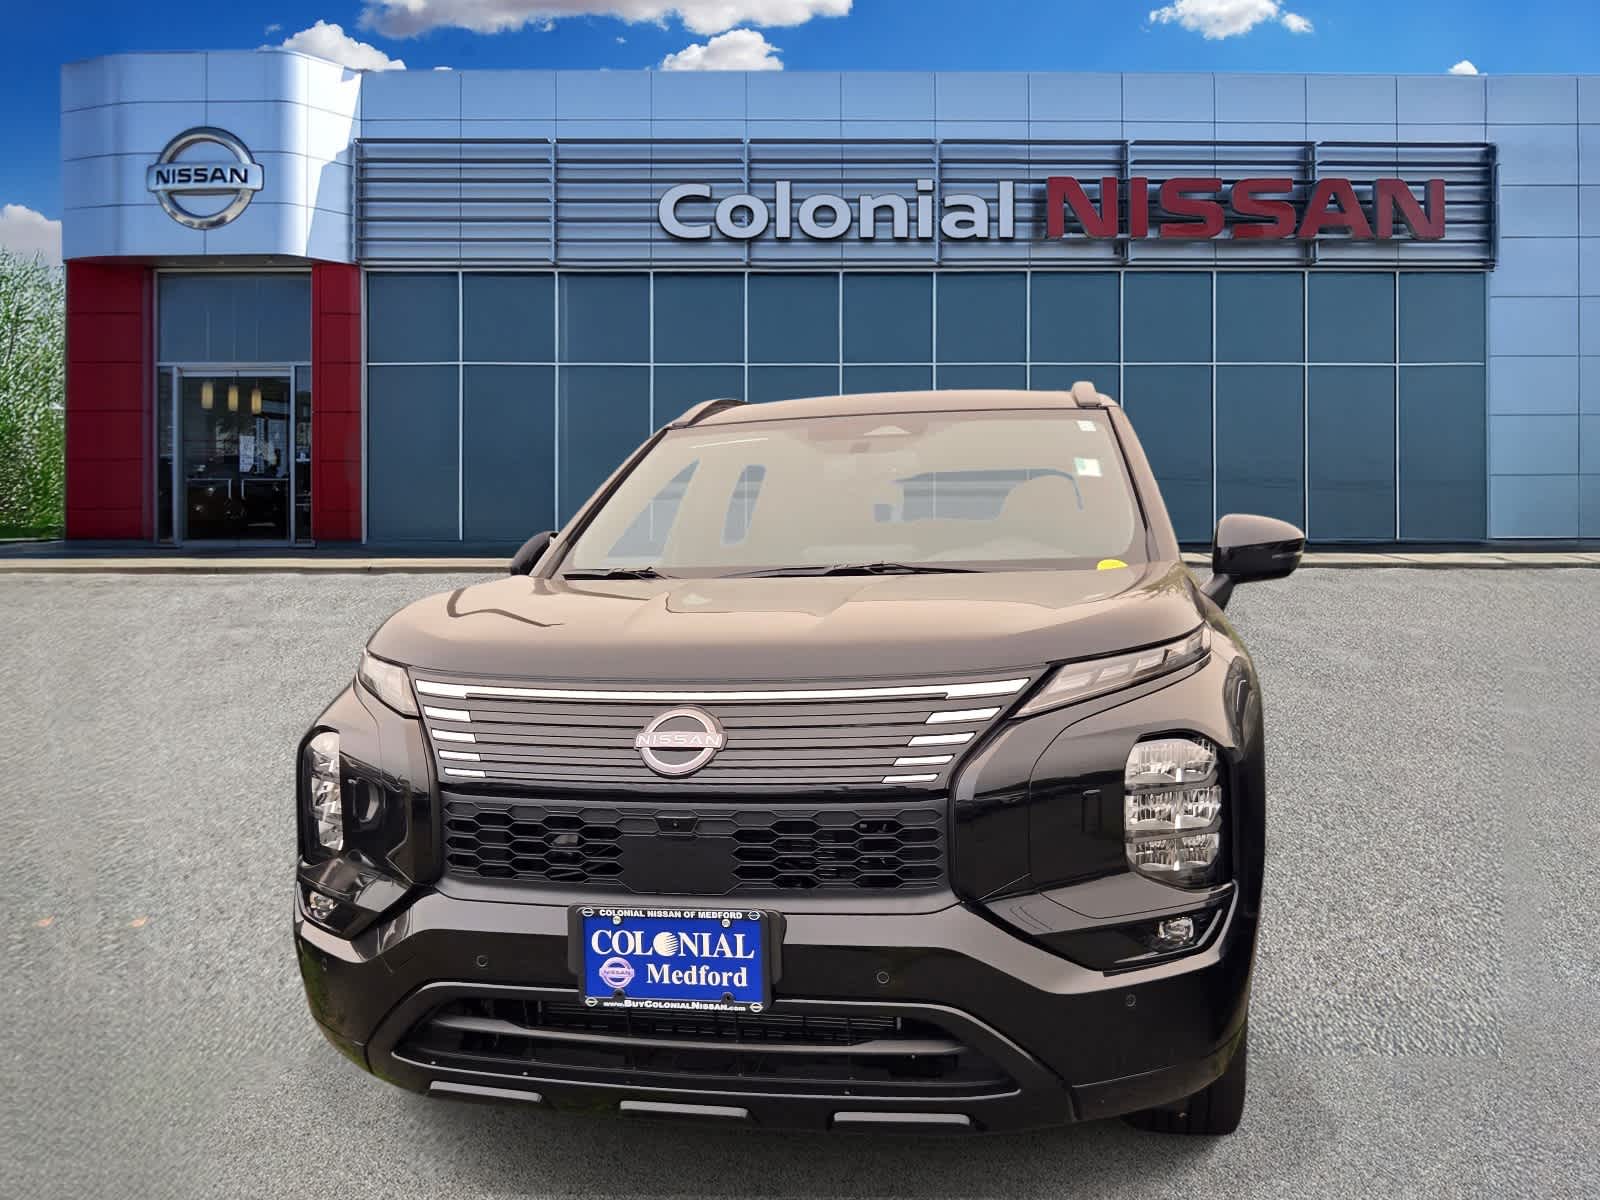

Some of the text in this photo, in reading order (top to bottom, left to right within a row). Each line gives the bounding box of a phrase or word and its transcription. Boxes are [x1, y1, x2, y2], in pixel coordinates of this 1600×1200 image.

[156, 167, 248, 184] NISSAN
[658, 176, 1446, 240] Colonial NISSAN
[639, 734, 719, 746] NISSAN
[599, 909, 743, 919] COLONIAL NISSAN OF MEDFORD
[591, 929, 755, 959] COLONIAL
[646, 963, 748, 988] Medford
